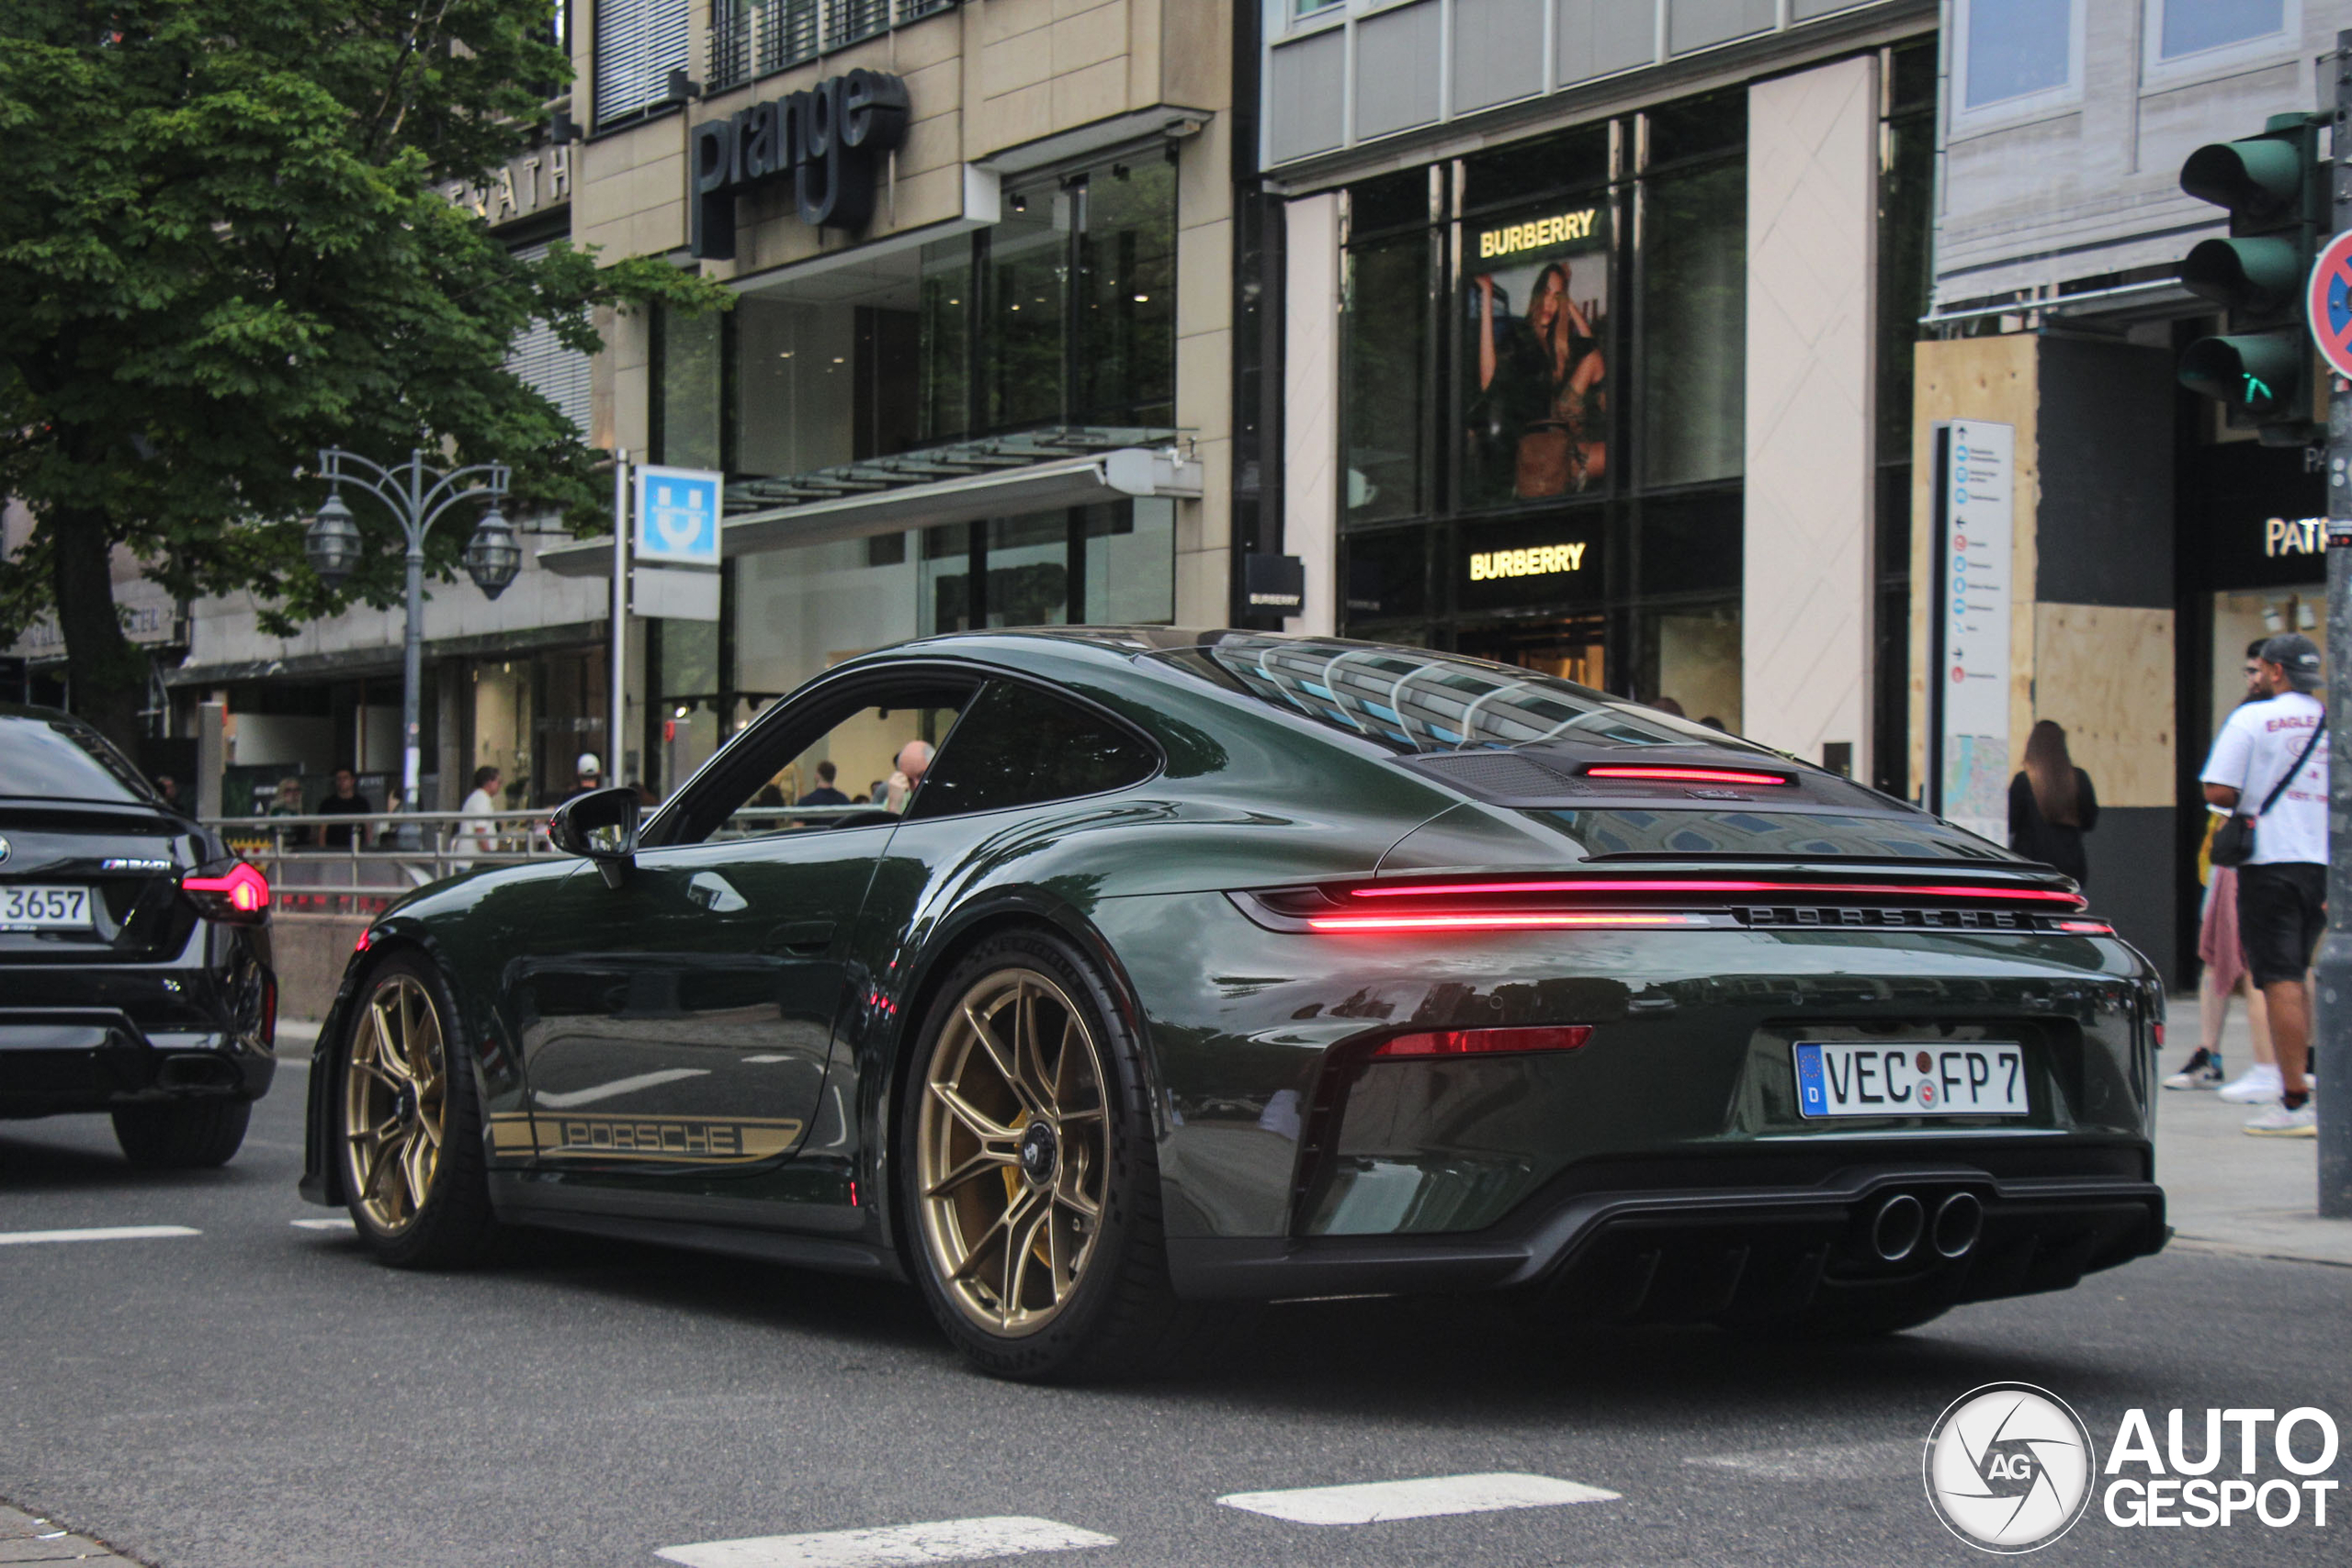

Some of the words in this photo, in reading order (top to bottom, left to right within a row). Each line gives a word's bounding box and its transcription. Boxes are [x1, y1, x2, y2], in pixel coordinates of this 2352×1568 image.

[692, 68, 884, 260] prange
[1480, 209, 1596, 258] BURBERRY
[1470, 542, 1587, 581] BURBERRY
[1250, 593, 1300, 605] BURBERRY
[6, 890, 85, 919] 3657
[1748, 907, 2016, 929] PORSCHE
[1826, 1051, 1912, 1104] VEC
[1808, 1087, 1820, 1103] D
[566, 1122, 736, 1155] PORSCHE
